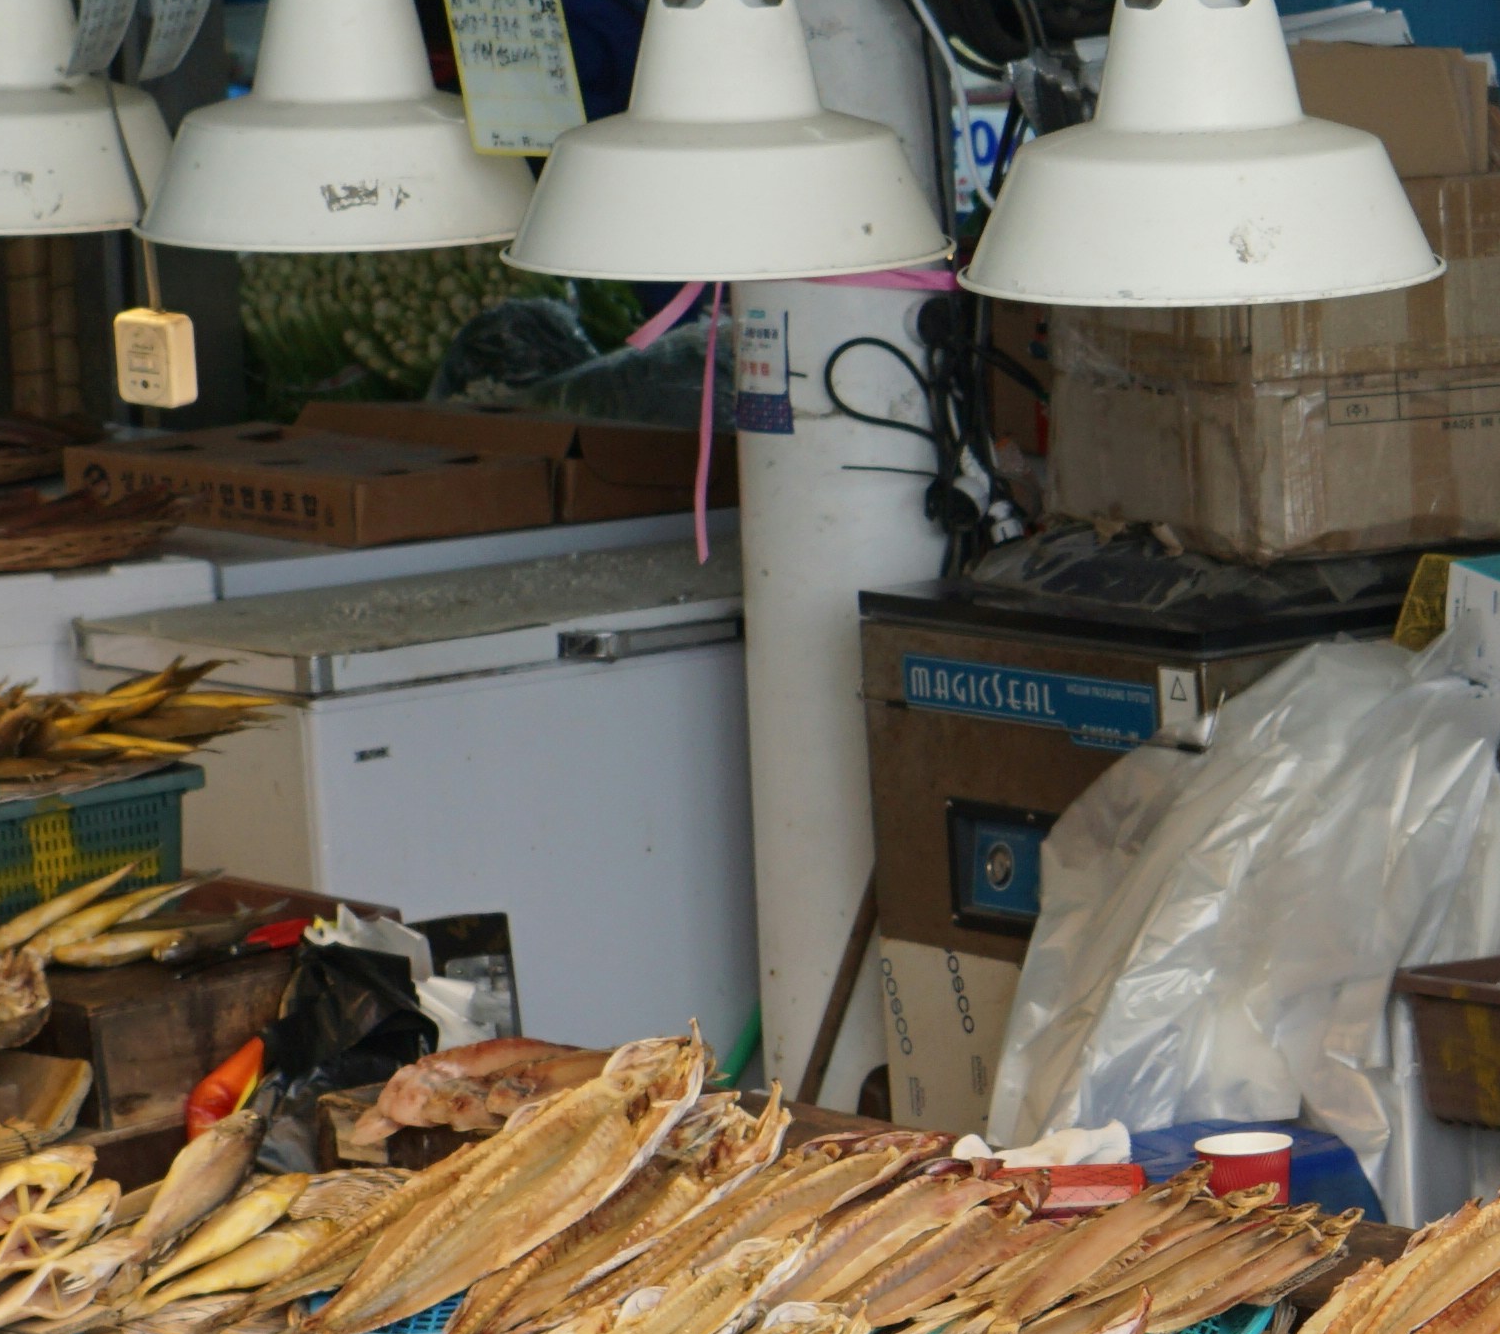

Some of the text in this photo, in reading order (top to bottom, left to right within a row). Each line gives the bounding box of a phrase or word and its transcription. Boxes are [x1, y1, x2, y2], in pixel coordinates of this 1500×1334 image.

[1442, 419, 1476, 431] MADE
[1481, 417, 1494, 429] IN
[945, 948, 976, 1035] OSCO
